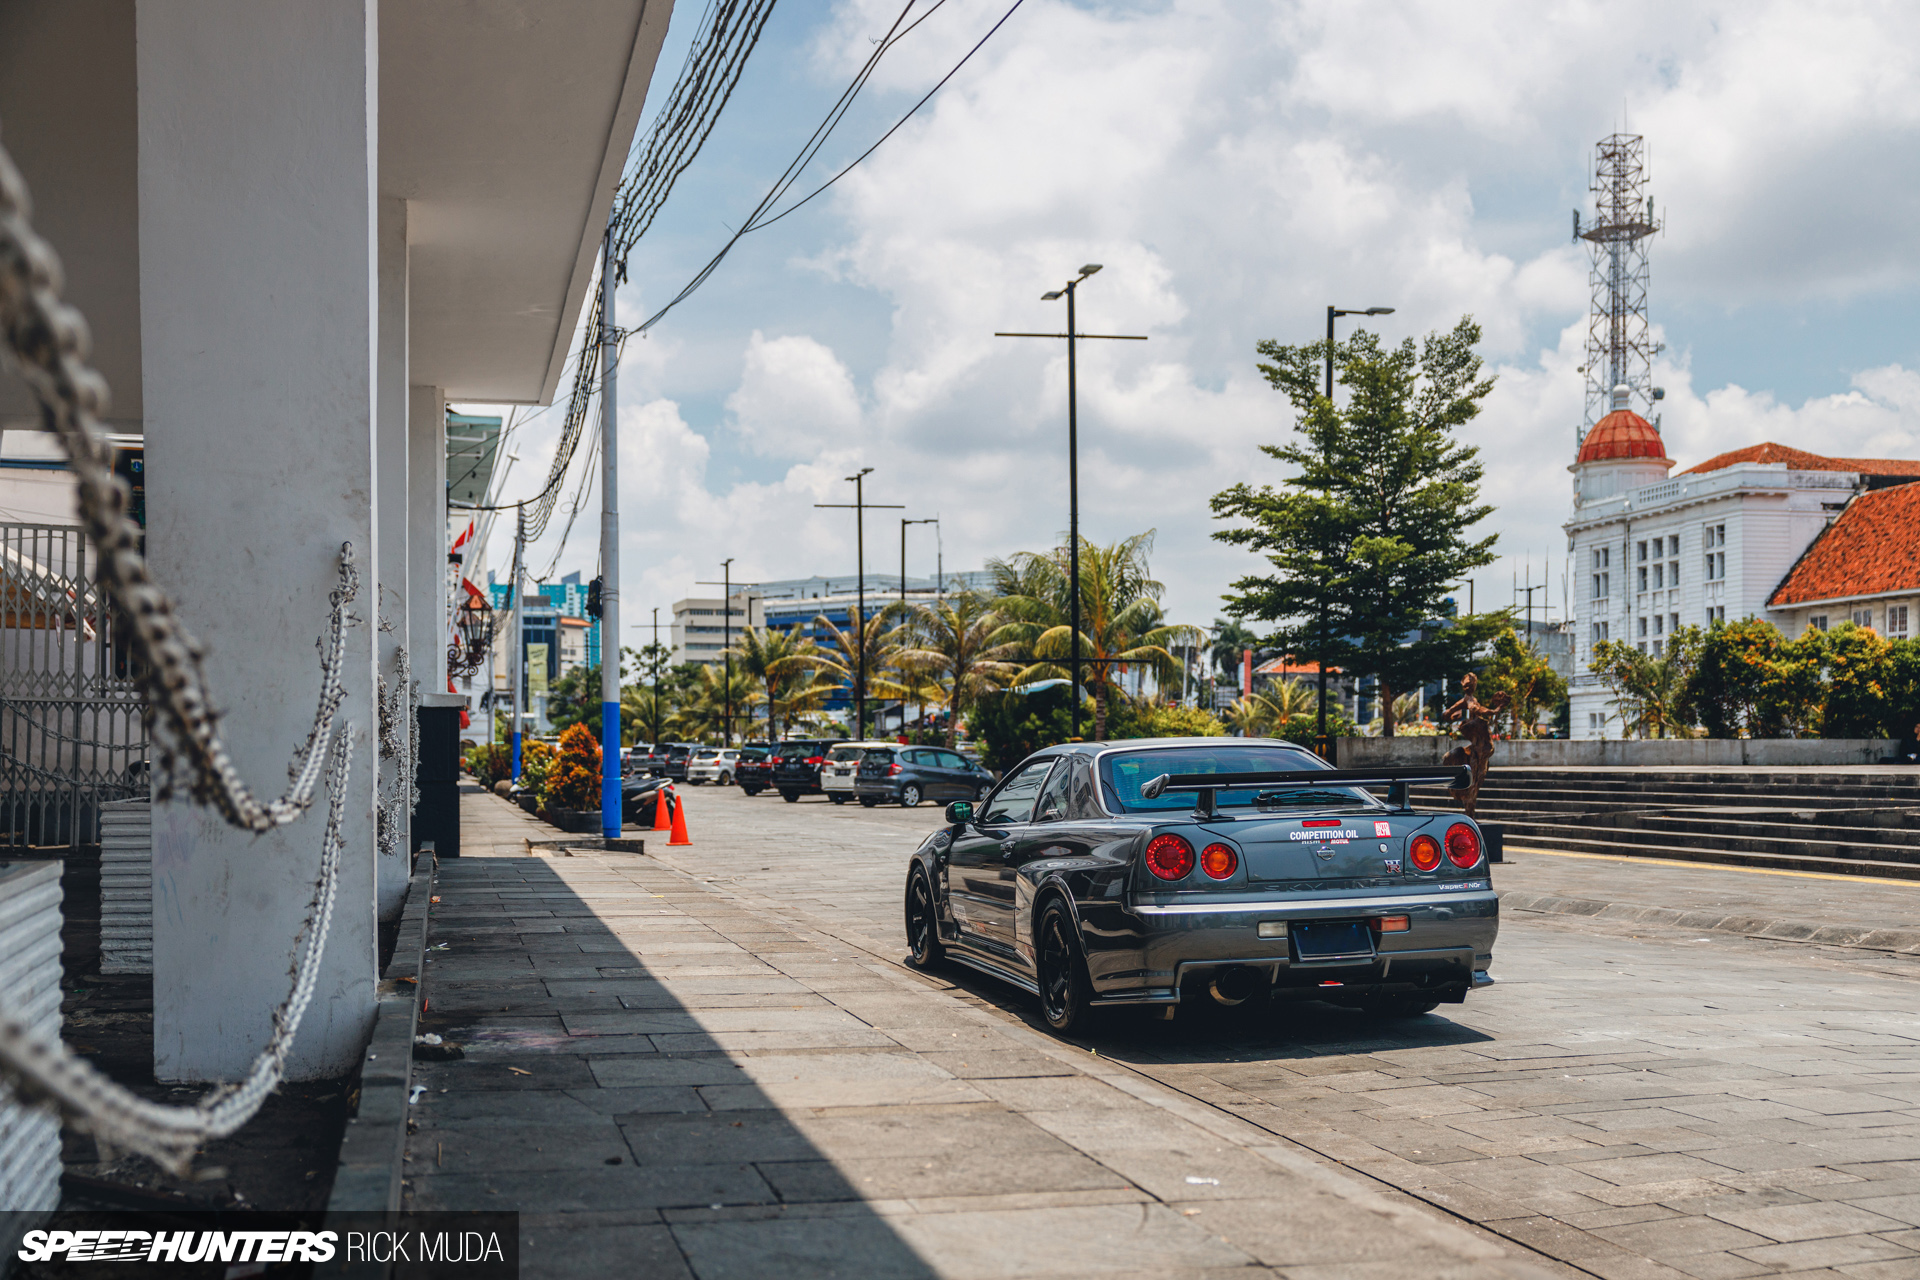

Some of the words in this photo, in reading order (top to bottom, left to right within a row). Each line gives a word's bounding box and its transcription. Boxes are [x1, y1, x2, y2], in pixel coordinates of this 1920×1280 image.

[1290, 830, 1344, 840] COMPETITION
[1345, 830, 1359, 839] OIL
[1264, 879, 1391, 893] SKYLINE
